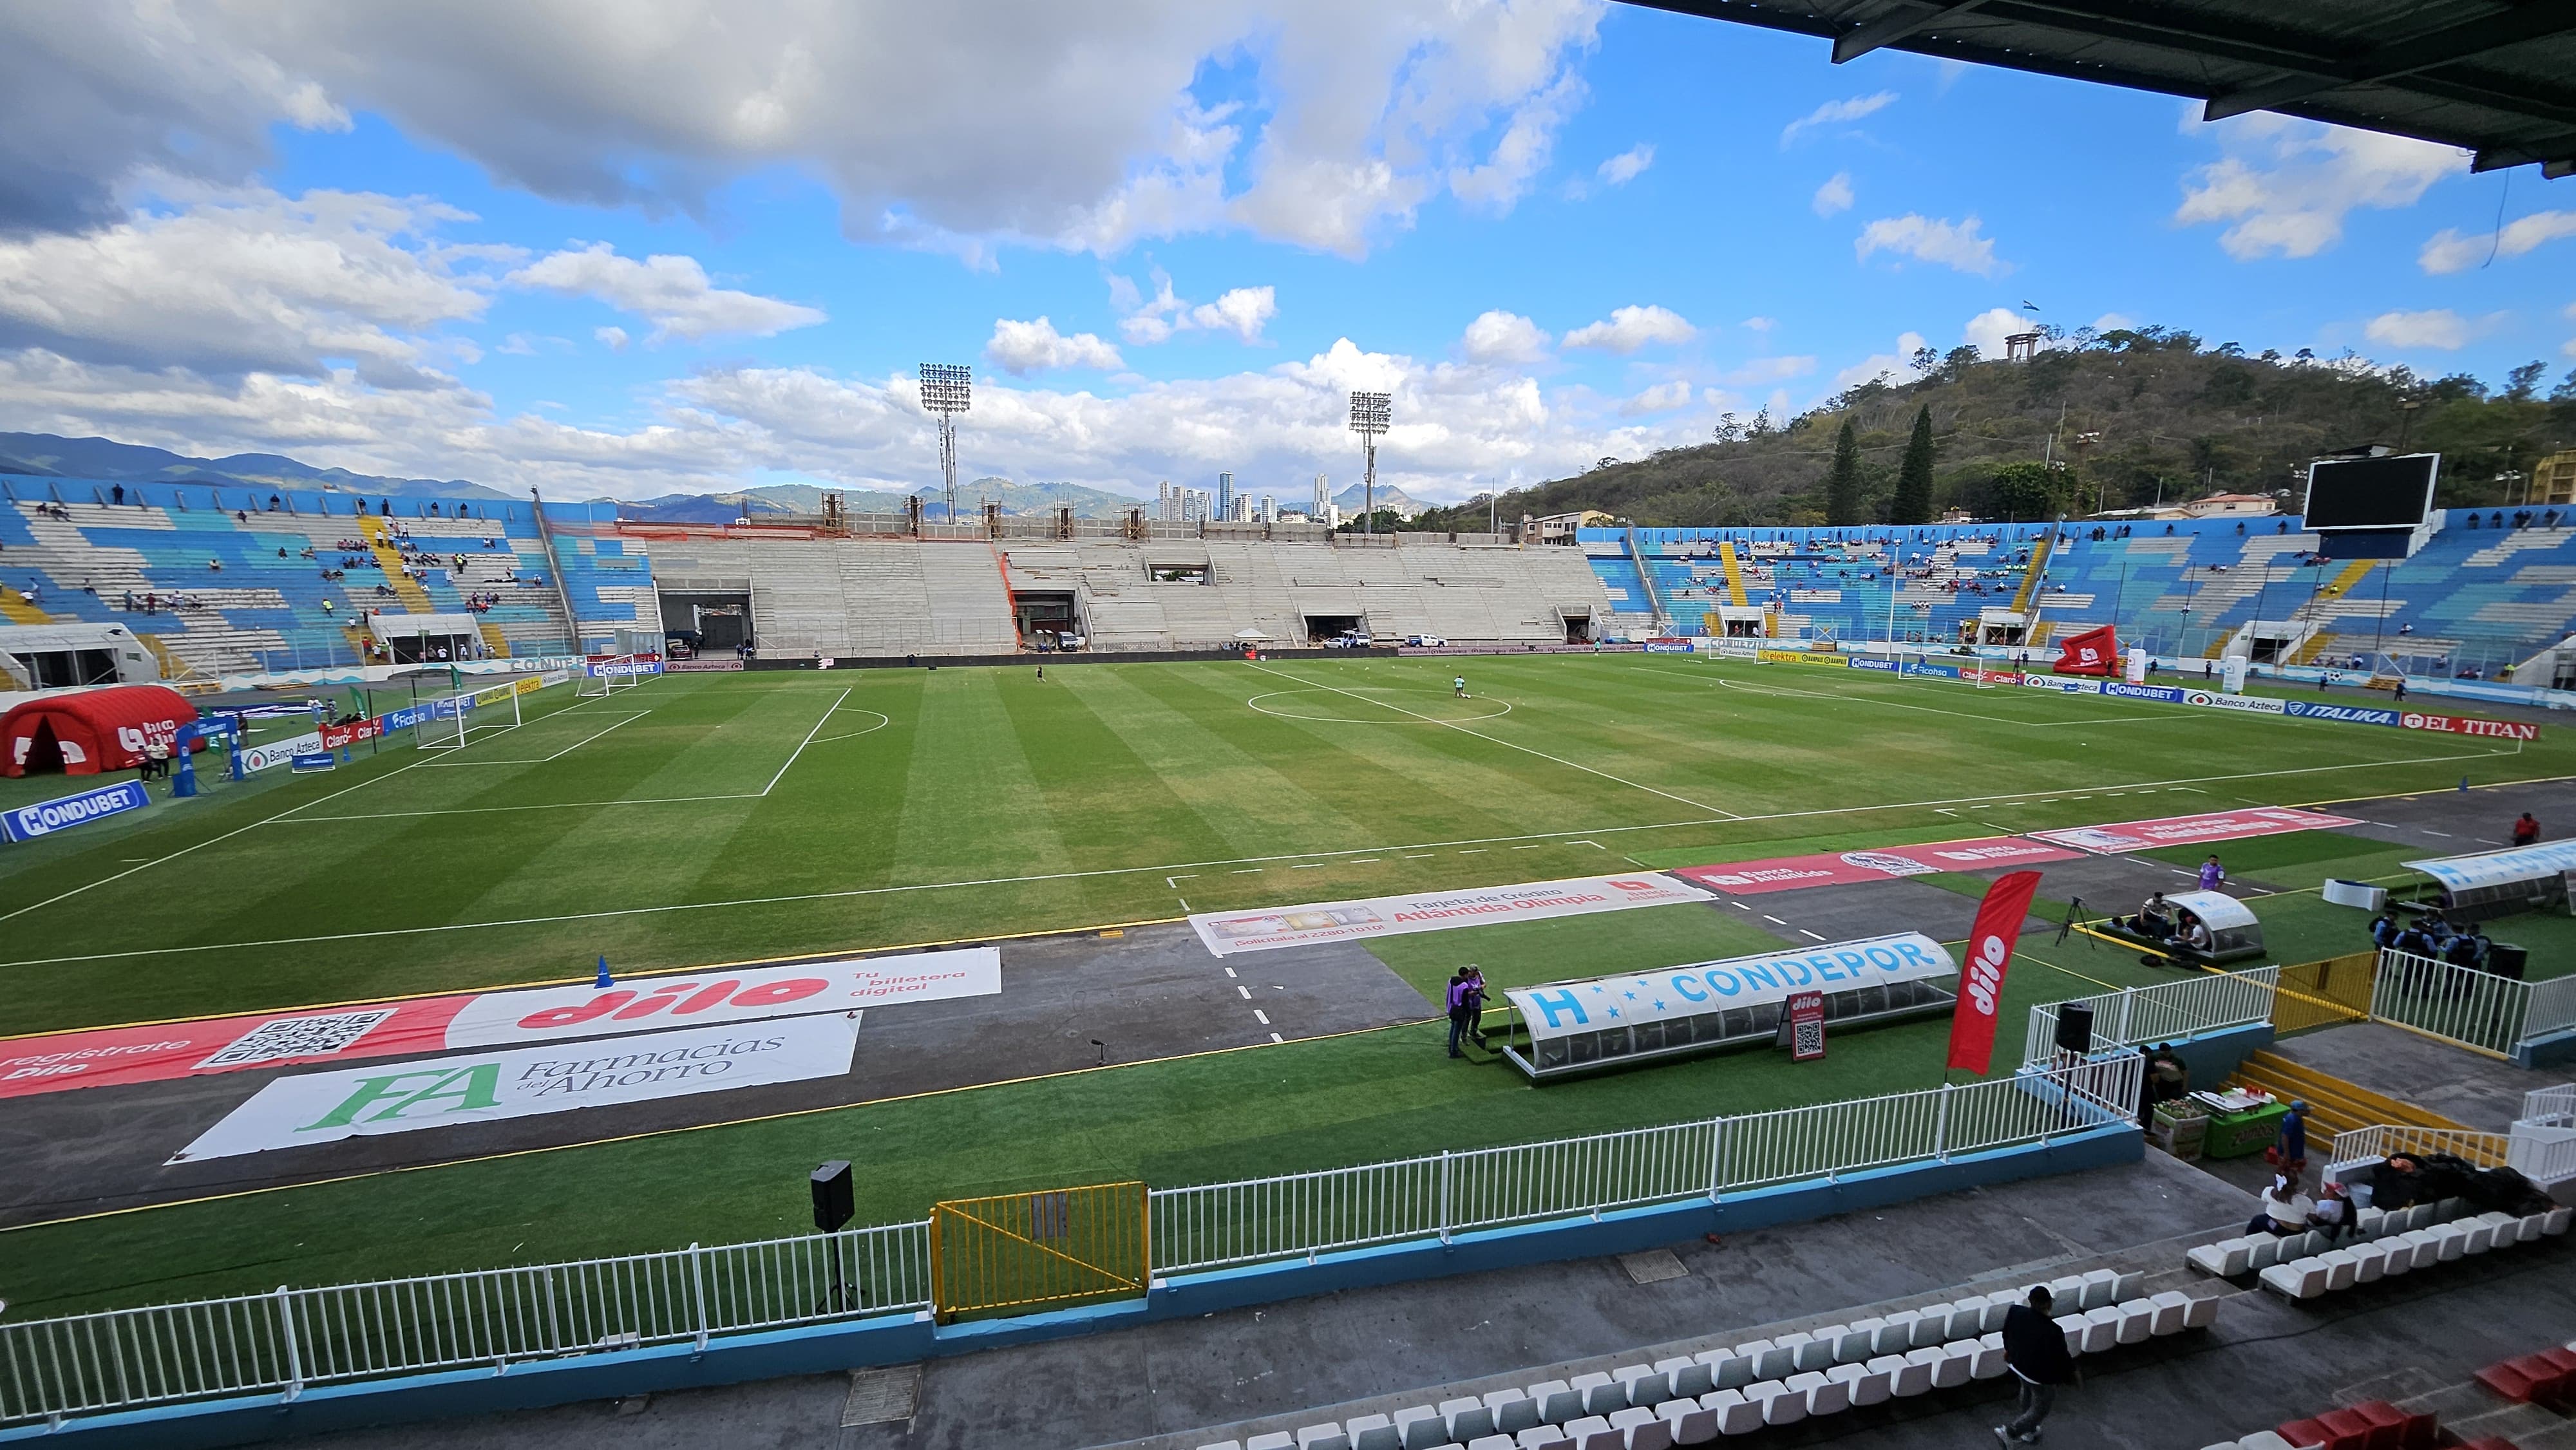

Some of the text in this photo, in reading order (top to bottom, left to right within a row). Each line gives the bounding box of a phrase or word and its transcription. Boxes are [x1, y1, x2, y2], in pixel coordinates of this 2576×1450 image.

[1770, 653, 1797, 662] elektra
[1852, 658, 1893, 670] HONDUBET
[1919, 666, 1947, 677] Ficohsa
[1994, 675, 2016, 684] Claro
[2047, 679, 2098, 692] Banc zteca
[2106, 683, 2174, 700] HONDUBET
[2215, 697, 2282, 712] Banco Azteca
[2306, 706, 2390, 724] ITALIKA
[2424, 716, 2454, 731] EL
[2462, 719, 2537, 739] TITAN
[326, 733, 348, 748] Claro
[270, 747, 294, 762] Banco
[296, 740, 320, 755] Azteca
[18, 789, 130, 836] HONDUBET
[1738, 869, 1793, 878] Banco
[1407, 897, 1475, 909] Tarjeta
[1501, 889, 1564, 900] Crédito
[1394, 893, 1607, 923] Atlántida Olimpia
[869, 972, 965, 986] billetera
[1967, 935, 2005, 1015] dilo
[850, 983, 927, 996] digital
[1530, 943, 1937, 1028] H CONDEPOR
[516, 978, 829, 1029] dilo
[1792, 996, 1821, 1011] dilo
[516, 1035, 786, 1082] Farmacias
[1, 1064, 90, 1080] Dilo
[516, 1060, 733, 1097] del Ahorro
[292, 1062, 503, 1133] FA
